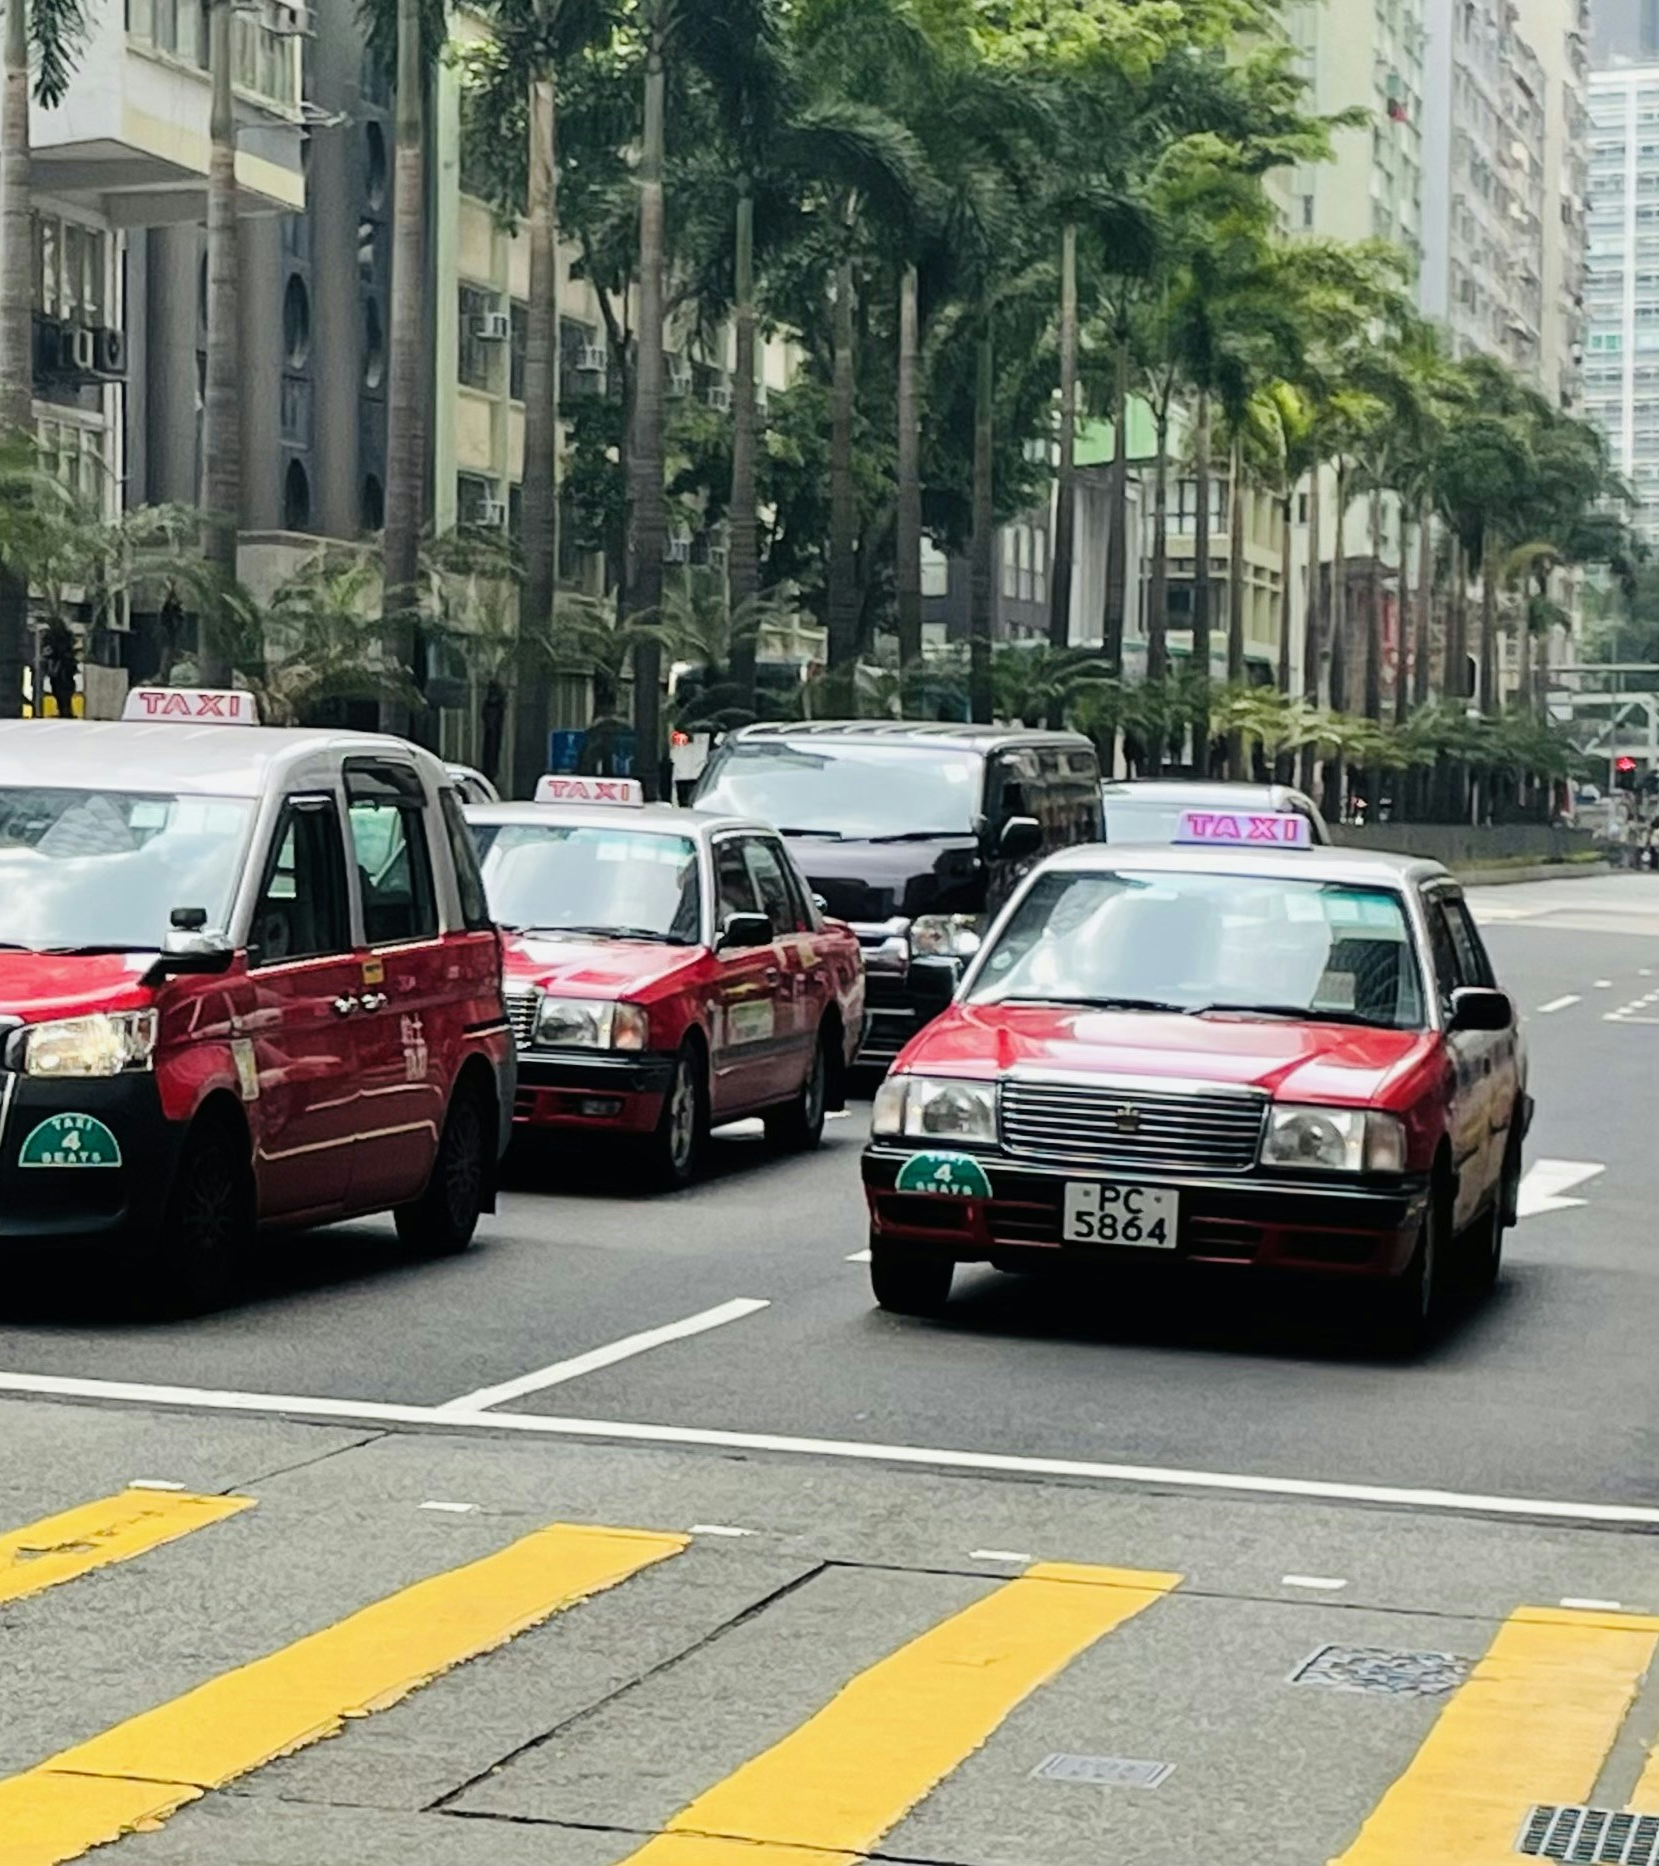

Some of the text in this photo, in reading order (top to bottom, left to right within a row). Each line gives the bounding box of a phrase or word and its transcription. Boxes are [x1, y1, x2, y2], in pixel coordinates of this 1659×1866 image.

[138, 691, 241, 718] TAXI
[547, 779, 631, 802] TAXI
[1187, 813, 1298, 842] TAXI
[51, 1116, 93, 1132] TAXI
[60, 1130, 81, 1151] 4
[42, 1151, 102, 1165] SEATS
[933, 1163, 953, 1183] 4
[1098, 1184, 1145, 1215] PC
[1073, 1210, 1167, 1246] 5864
